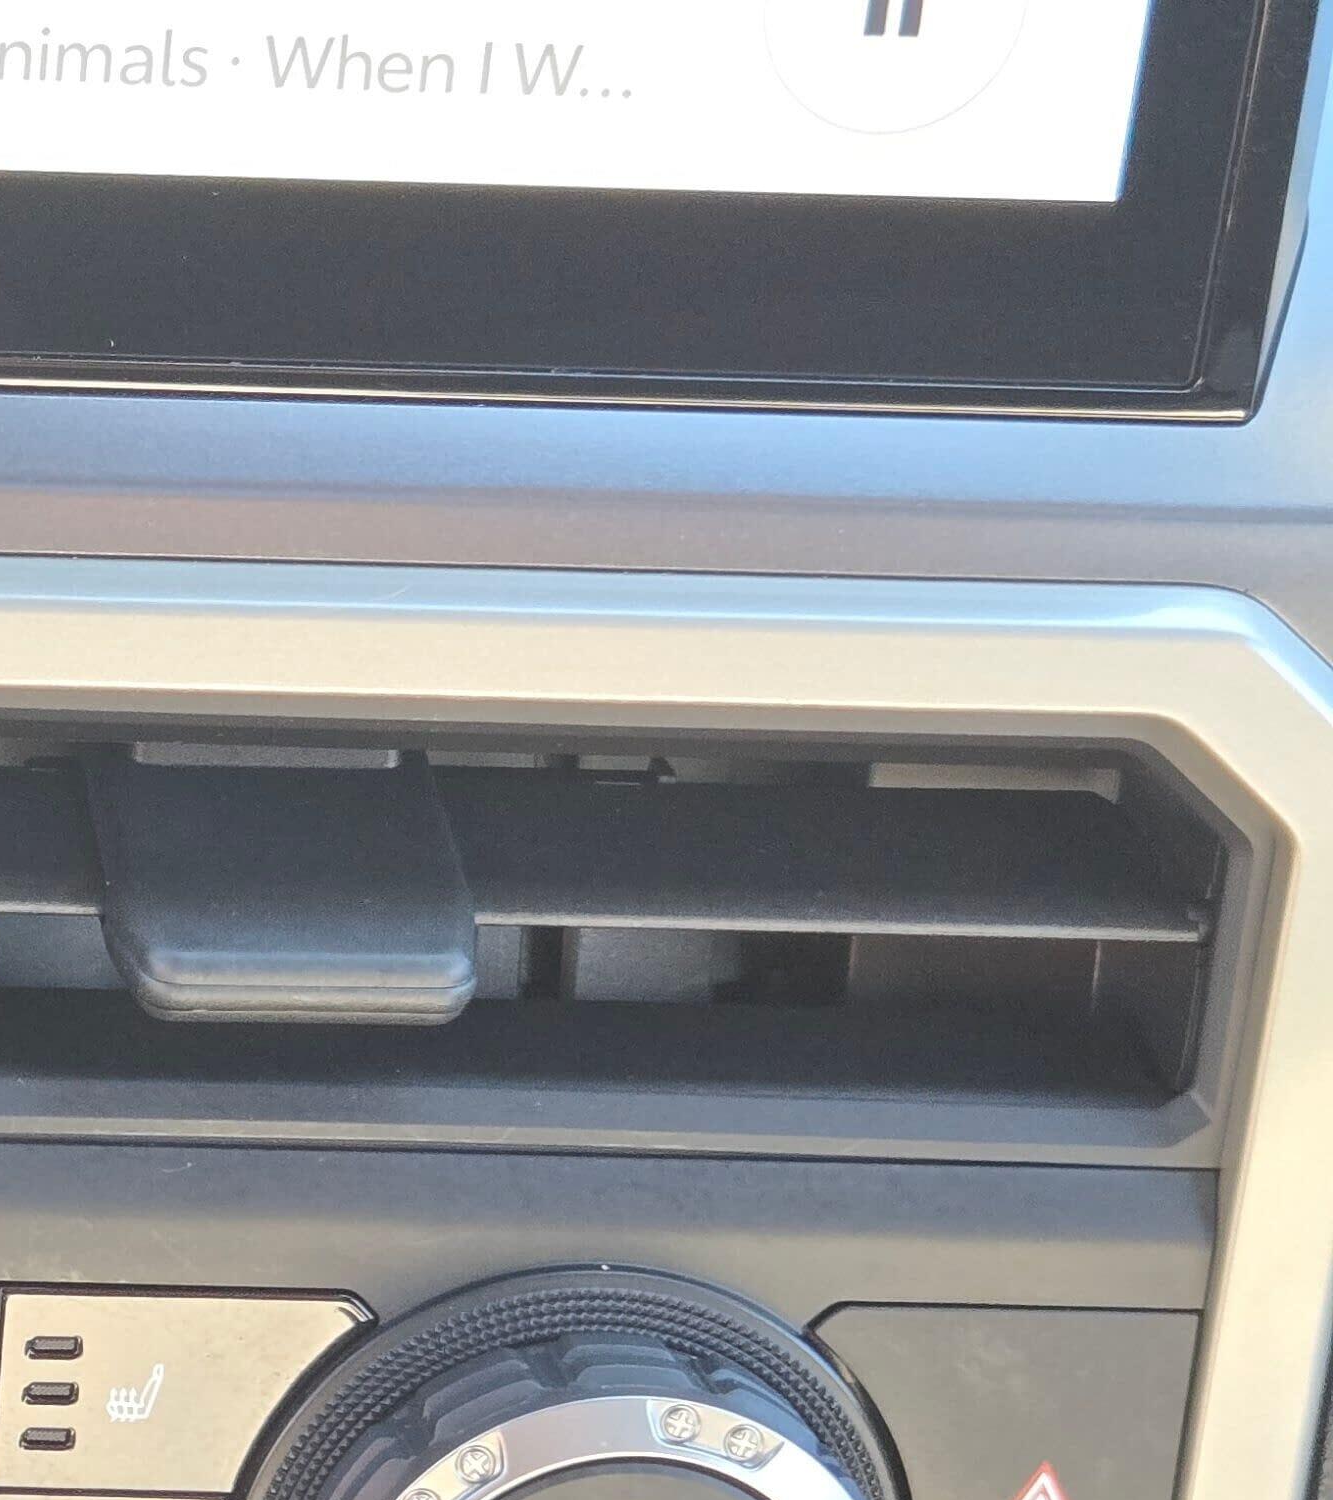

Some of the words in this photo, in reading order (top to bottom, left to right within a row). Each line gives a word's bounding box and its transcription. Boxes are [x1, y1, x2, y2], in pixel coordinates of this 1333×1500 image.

[266, 34, 455, 94] When
[479, 41, 494, 94] I
[515, 42, 632, 99] W...
